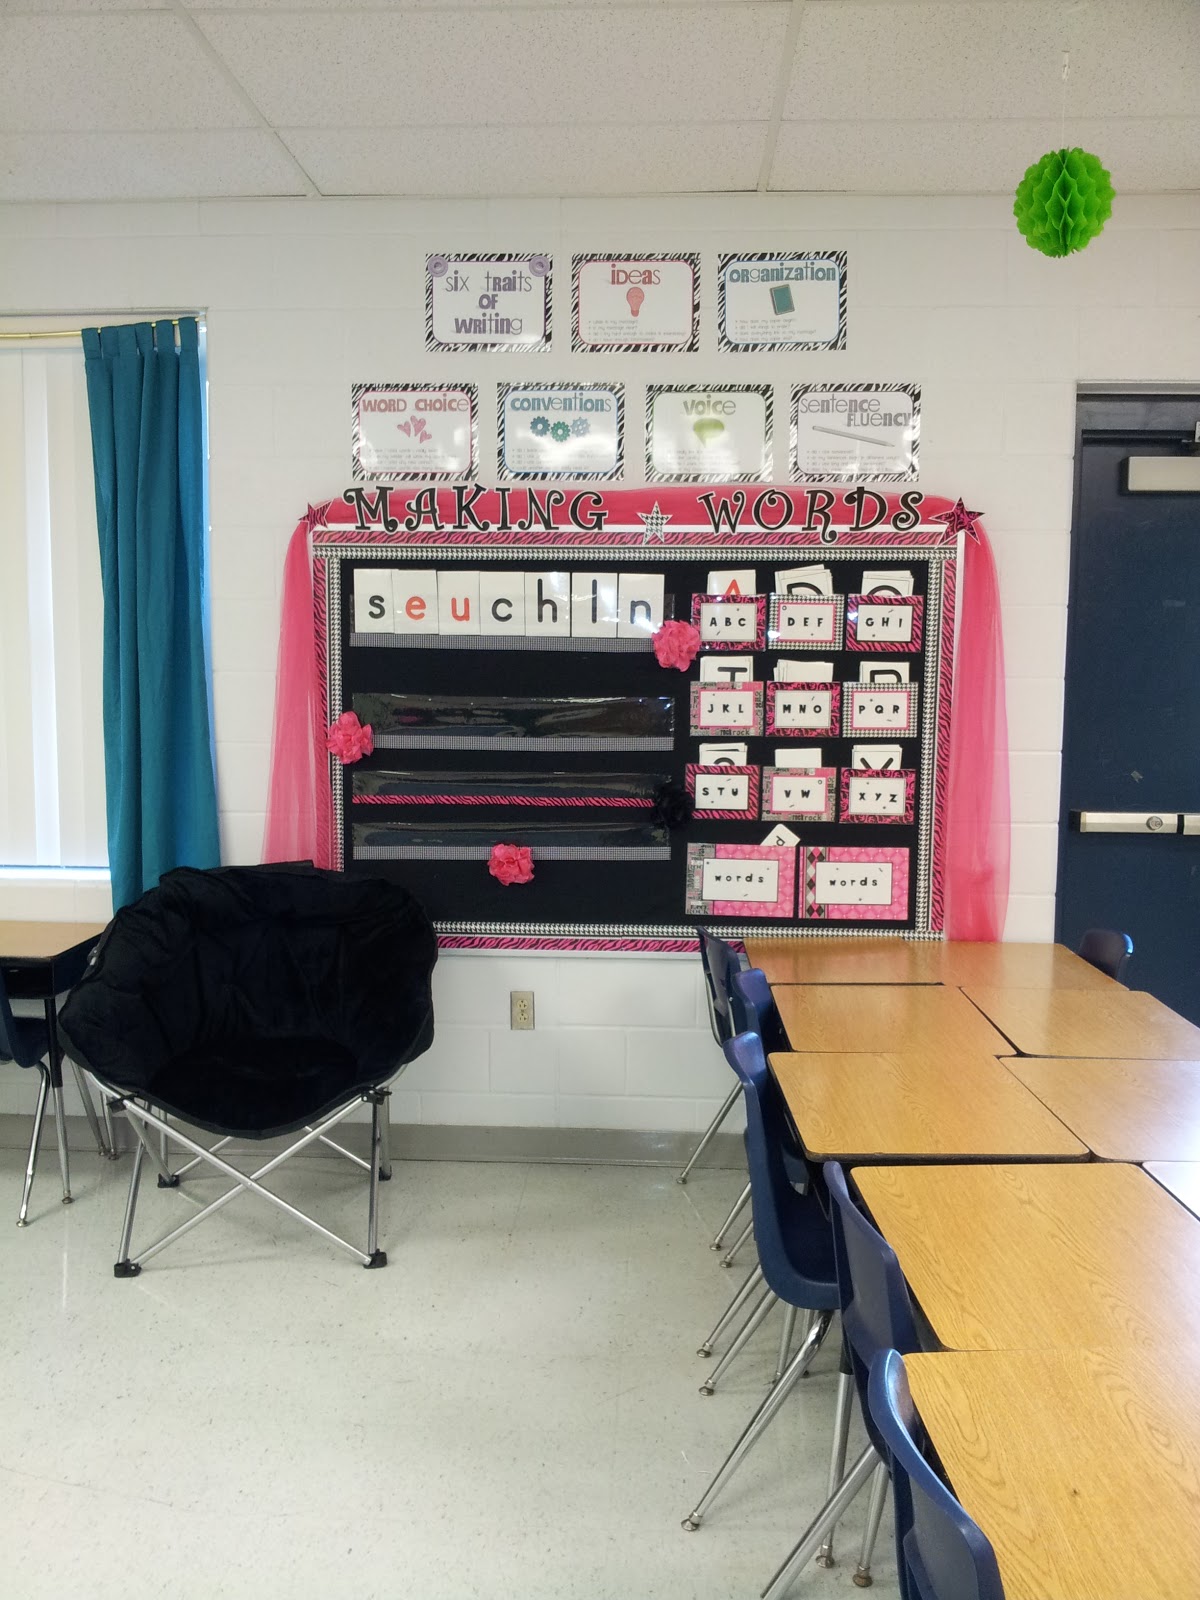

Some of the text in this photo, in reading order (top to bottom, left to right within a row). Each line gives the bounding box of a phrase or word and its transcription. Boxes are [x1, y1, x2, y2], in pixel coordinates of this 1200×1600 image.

[446, 270, 470, 292] six
[510, 392, 612, 412] conventions
[683, 394, 736, 415] voice
[800, 393, 881, 413] sentence
[343, 484, 923, 542] MAKING WORDS
[714, 873, 764, 883] words
[829, 876, 878, 887] words
